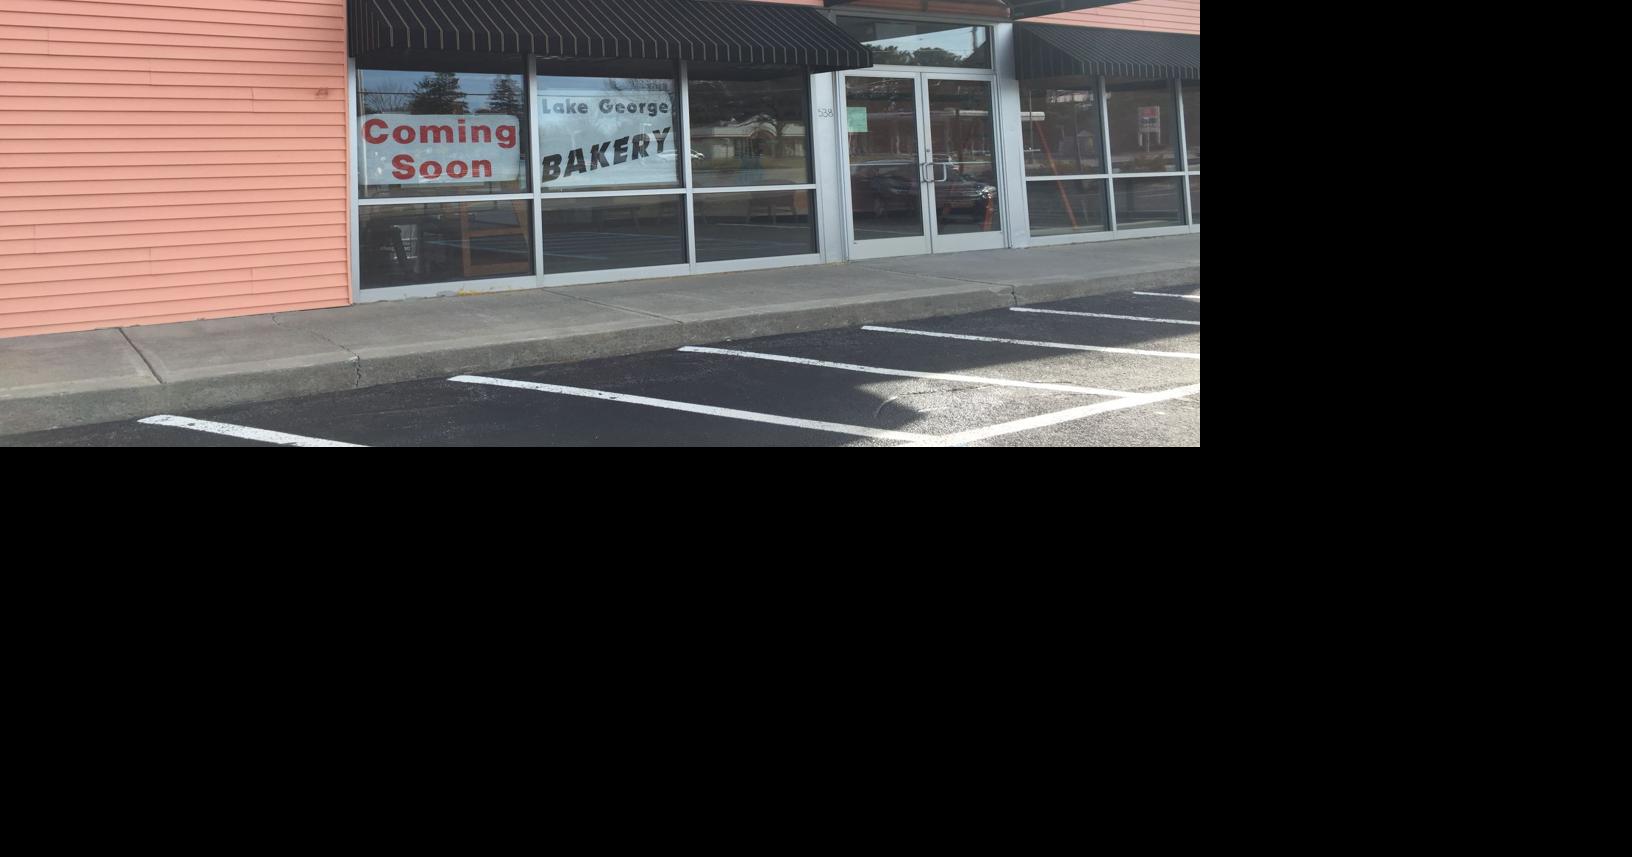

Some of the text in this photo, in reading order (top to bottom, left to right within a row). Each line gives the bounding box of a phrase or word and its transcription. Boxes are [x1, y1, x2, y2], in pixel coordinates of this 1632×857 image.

[542, 98, 669, 117] Lake George
[817, 108, 833, 118] 538
[363, 118, 517, 149] Coming
[391, 154, 493, 180] Soon
[541, 126, 671, 182] BAKERY
